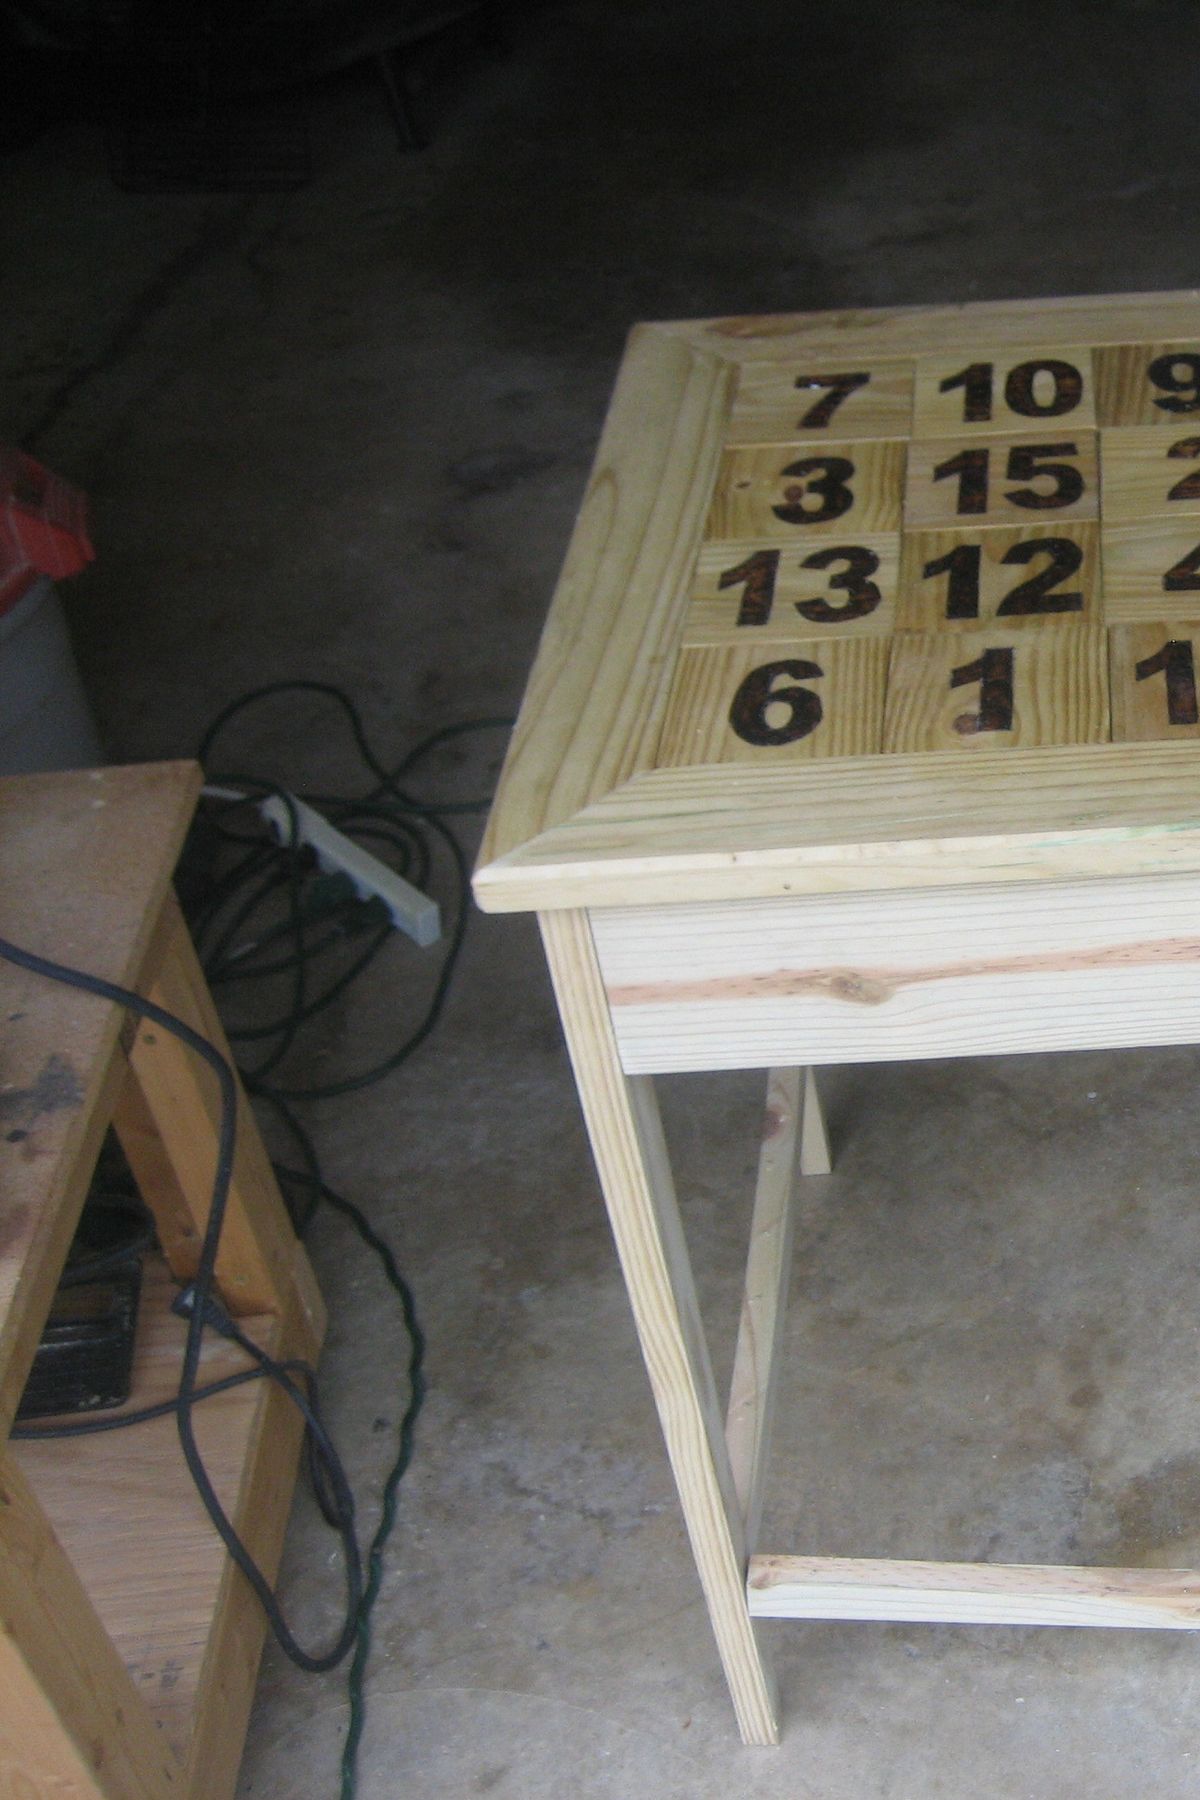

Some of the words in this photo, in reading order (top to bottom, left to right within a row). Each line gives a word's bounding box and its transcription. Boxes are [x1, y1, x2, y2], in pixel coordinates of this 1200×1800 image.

[795, 372, 870, 429] 7
[939, 359, 1084, 422] 10
[771, 457, 856, 524] 3
[934, 442, 1085, 514] 15
[716, 546, 882, 626] 13
[921, 537, 1084, 619] 12
[728, 659, 824, 746] 6
[949, 647, 1014, 733] 1
